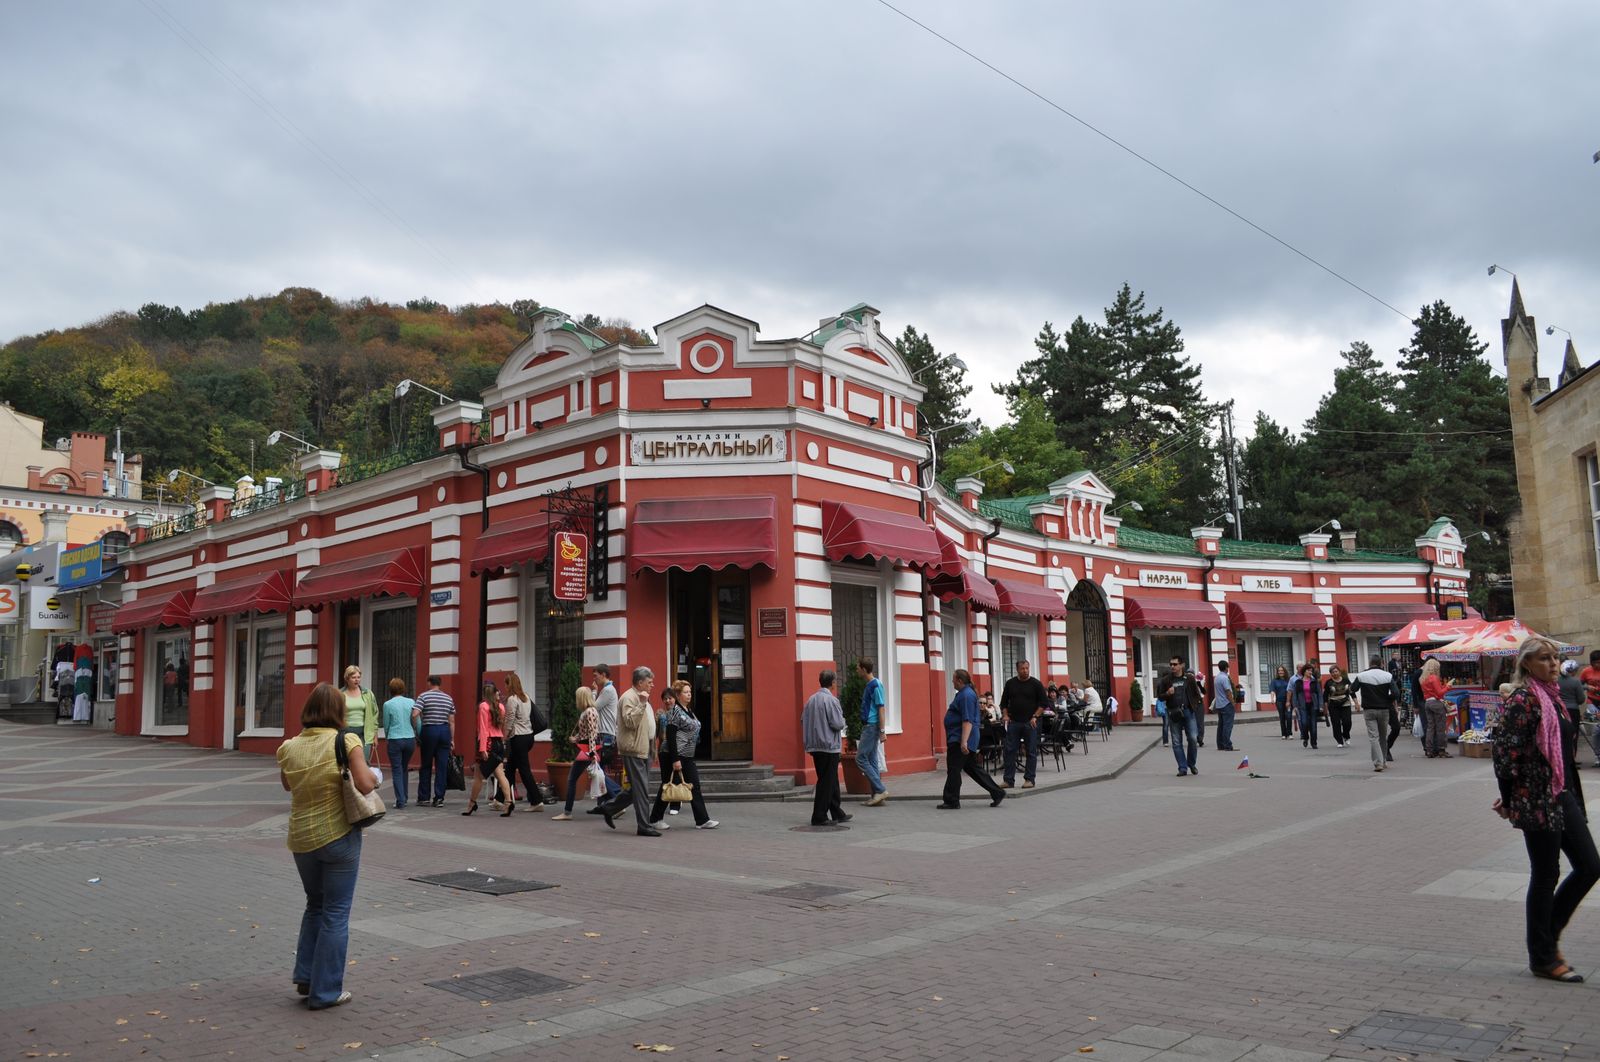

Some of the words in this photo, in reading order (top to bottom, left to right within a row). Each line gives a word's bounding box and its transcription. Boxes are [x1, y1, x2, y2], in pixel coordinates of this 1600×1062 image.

[676, 433, 741, 441] МАГАЗИН
[643, 434, 773, 462] ЦЕНТРАЛЬНЫЙ
[1147, 574, 1182, 585] НАРЗАН
[1256, 579, 1281, 589] ХЛЕБ
[38, 611, 69, 620] Билайн
